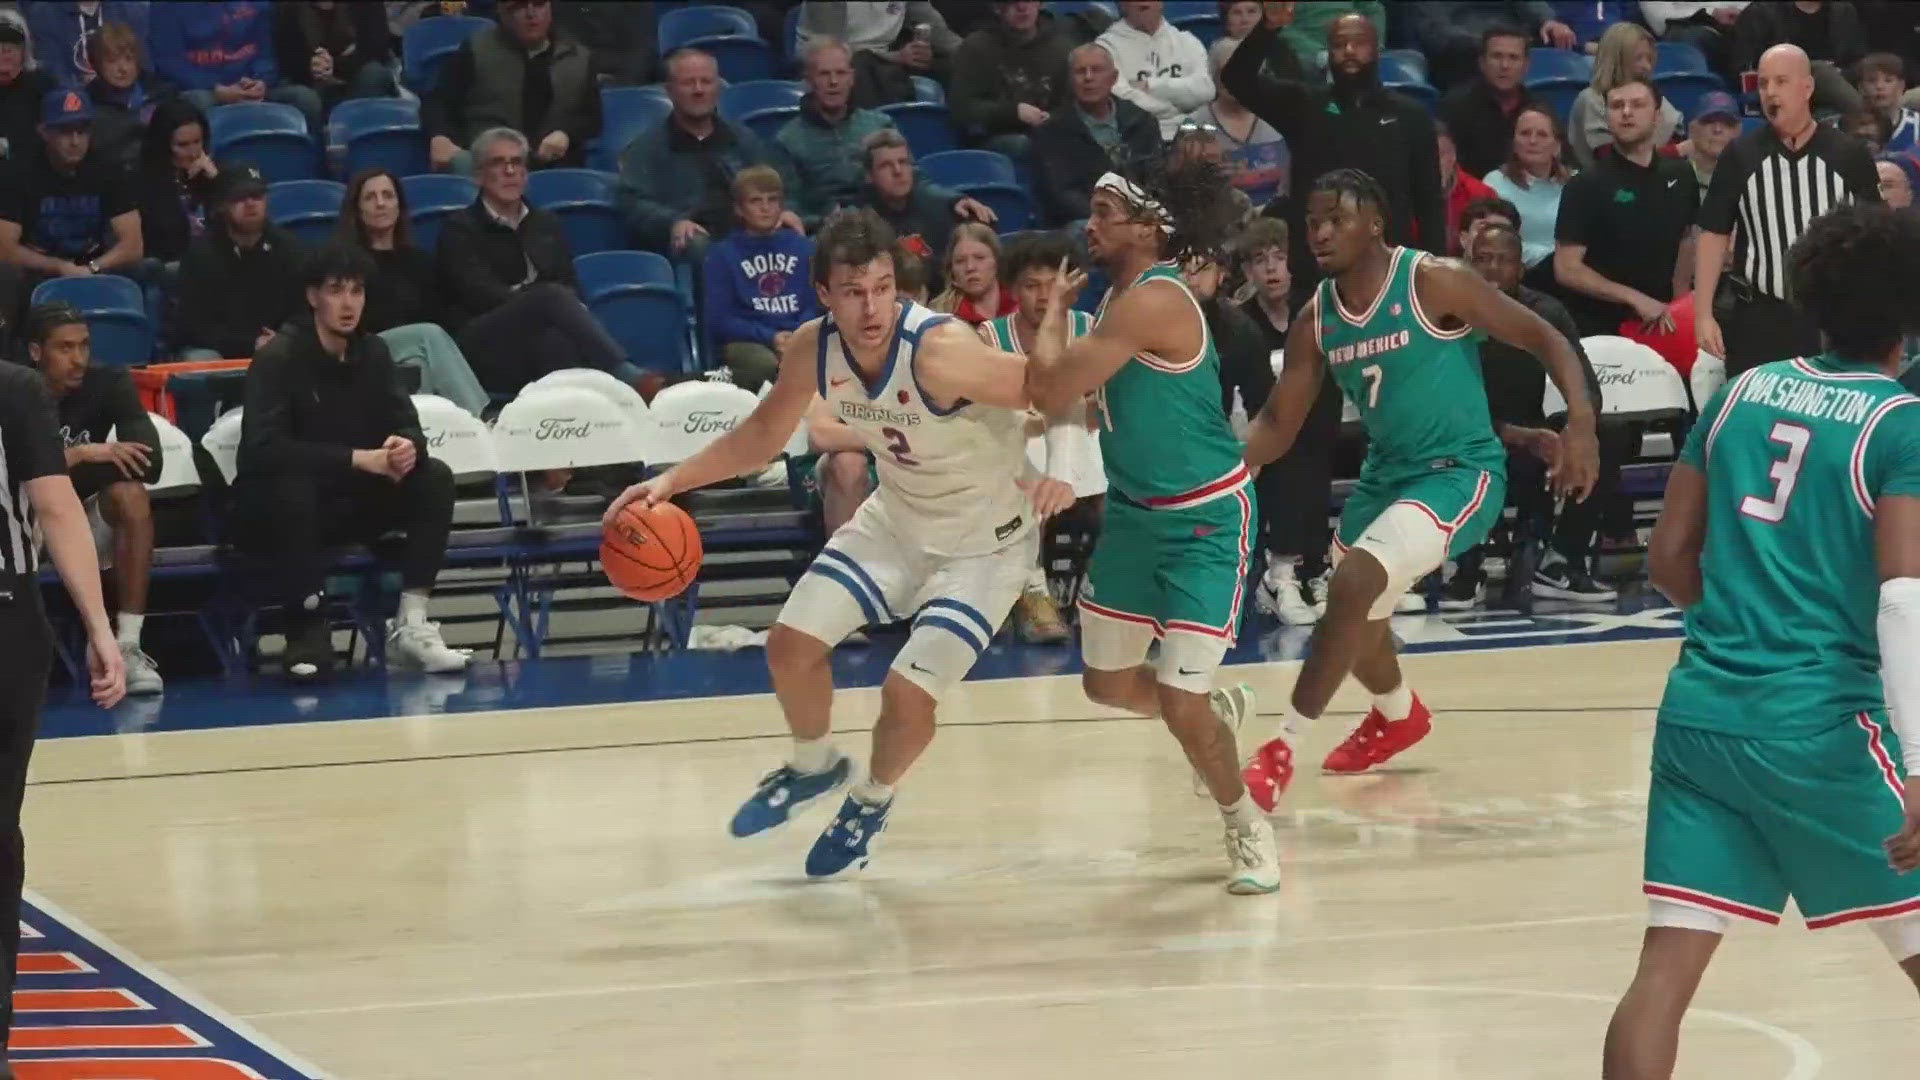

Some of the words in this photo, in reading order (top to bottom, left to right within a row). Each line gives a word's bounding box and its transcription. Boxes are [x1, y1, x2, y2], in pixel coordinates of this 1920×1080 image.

[741, 252, 799, 279] BOISE
[752, 294, 800, 313] STATE
[1328, 345, 1354, 365] NEW
[1356, 329, 1409, 359] MEXICO
[1361, 364, 1382, 408] 7
[1741, 372, 1876, 425] WASHINGTON
[535, 418, 591, 441] Ford
[684, 410, 738, 434] Ford
[882, 426, 922, 466] 2
[1739, 420, 1811, 524] 3
